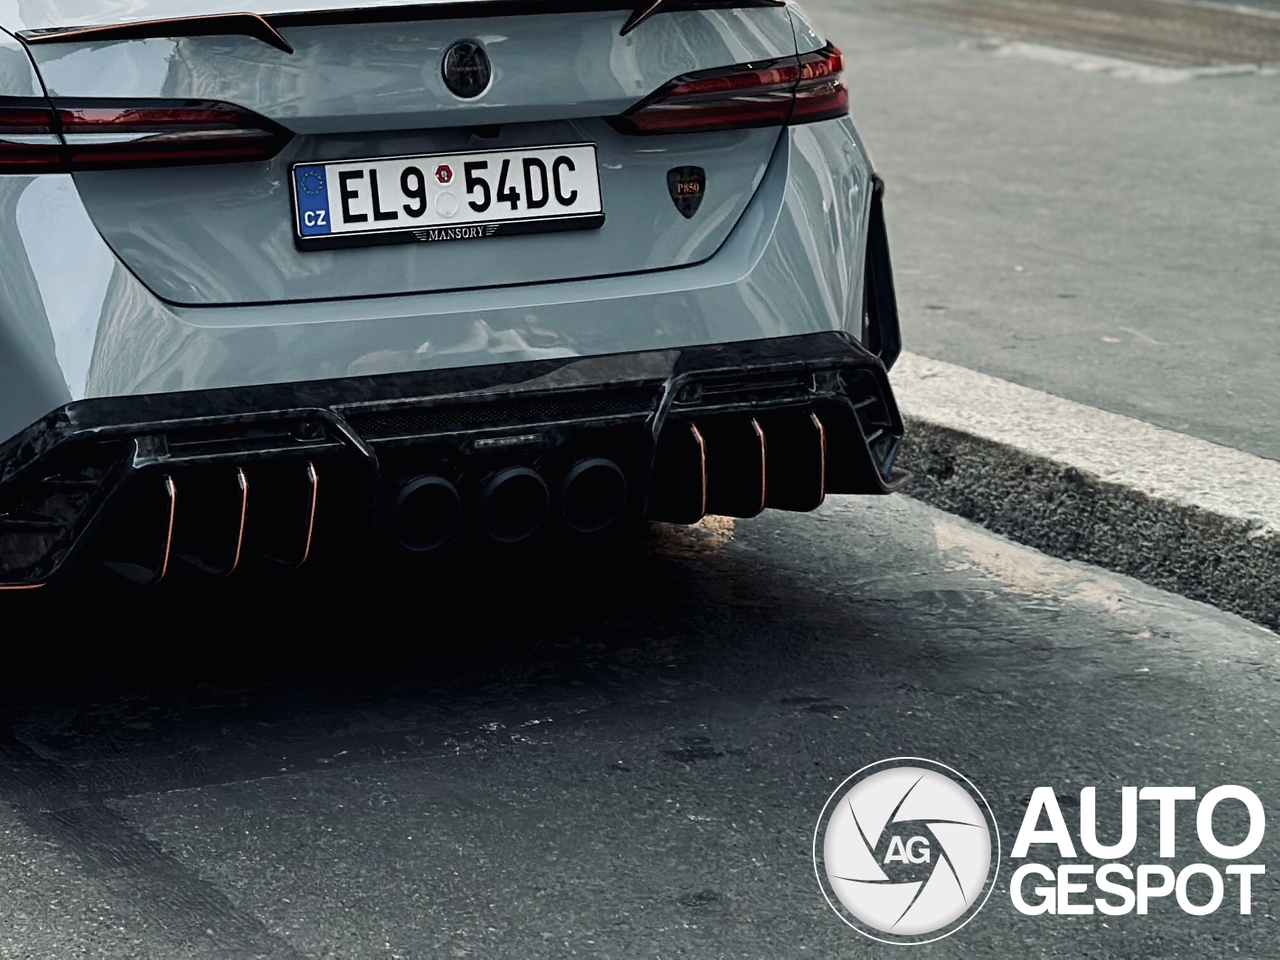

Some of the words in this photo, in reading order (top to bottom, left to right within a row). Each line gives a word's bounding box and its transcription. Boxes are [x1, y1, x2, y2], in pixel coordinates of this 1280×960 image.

[338, 166, 427, 223] EL9
[464, 156, 578, 213] 54DC
[304, 210, 326, 226] CZ
[428, 226, 484, 241] MANSORY
